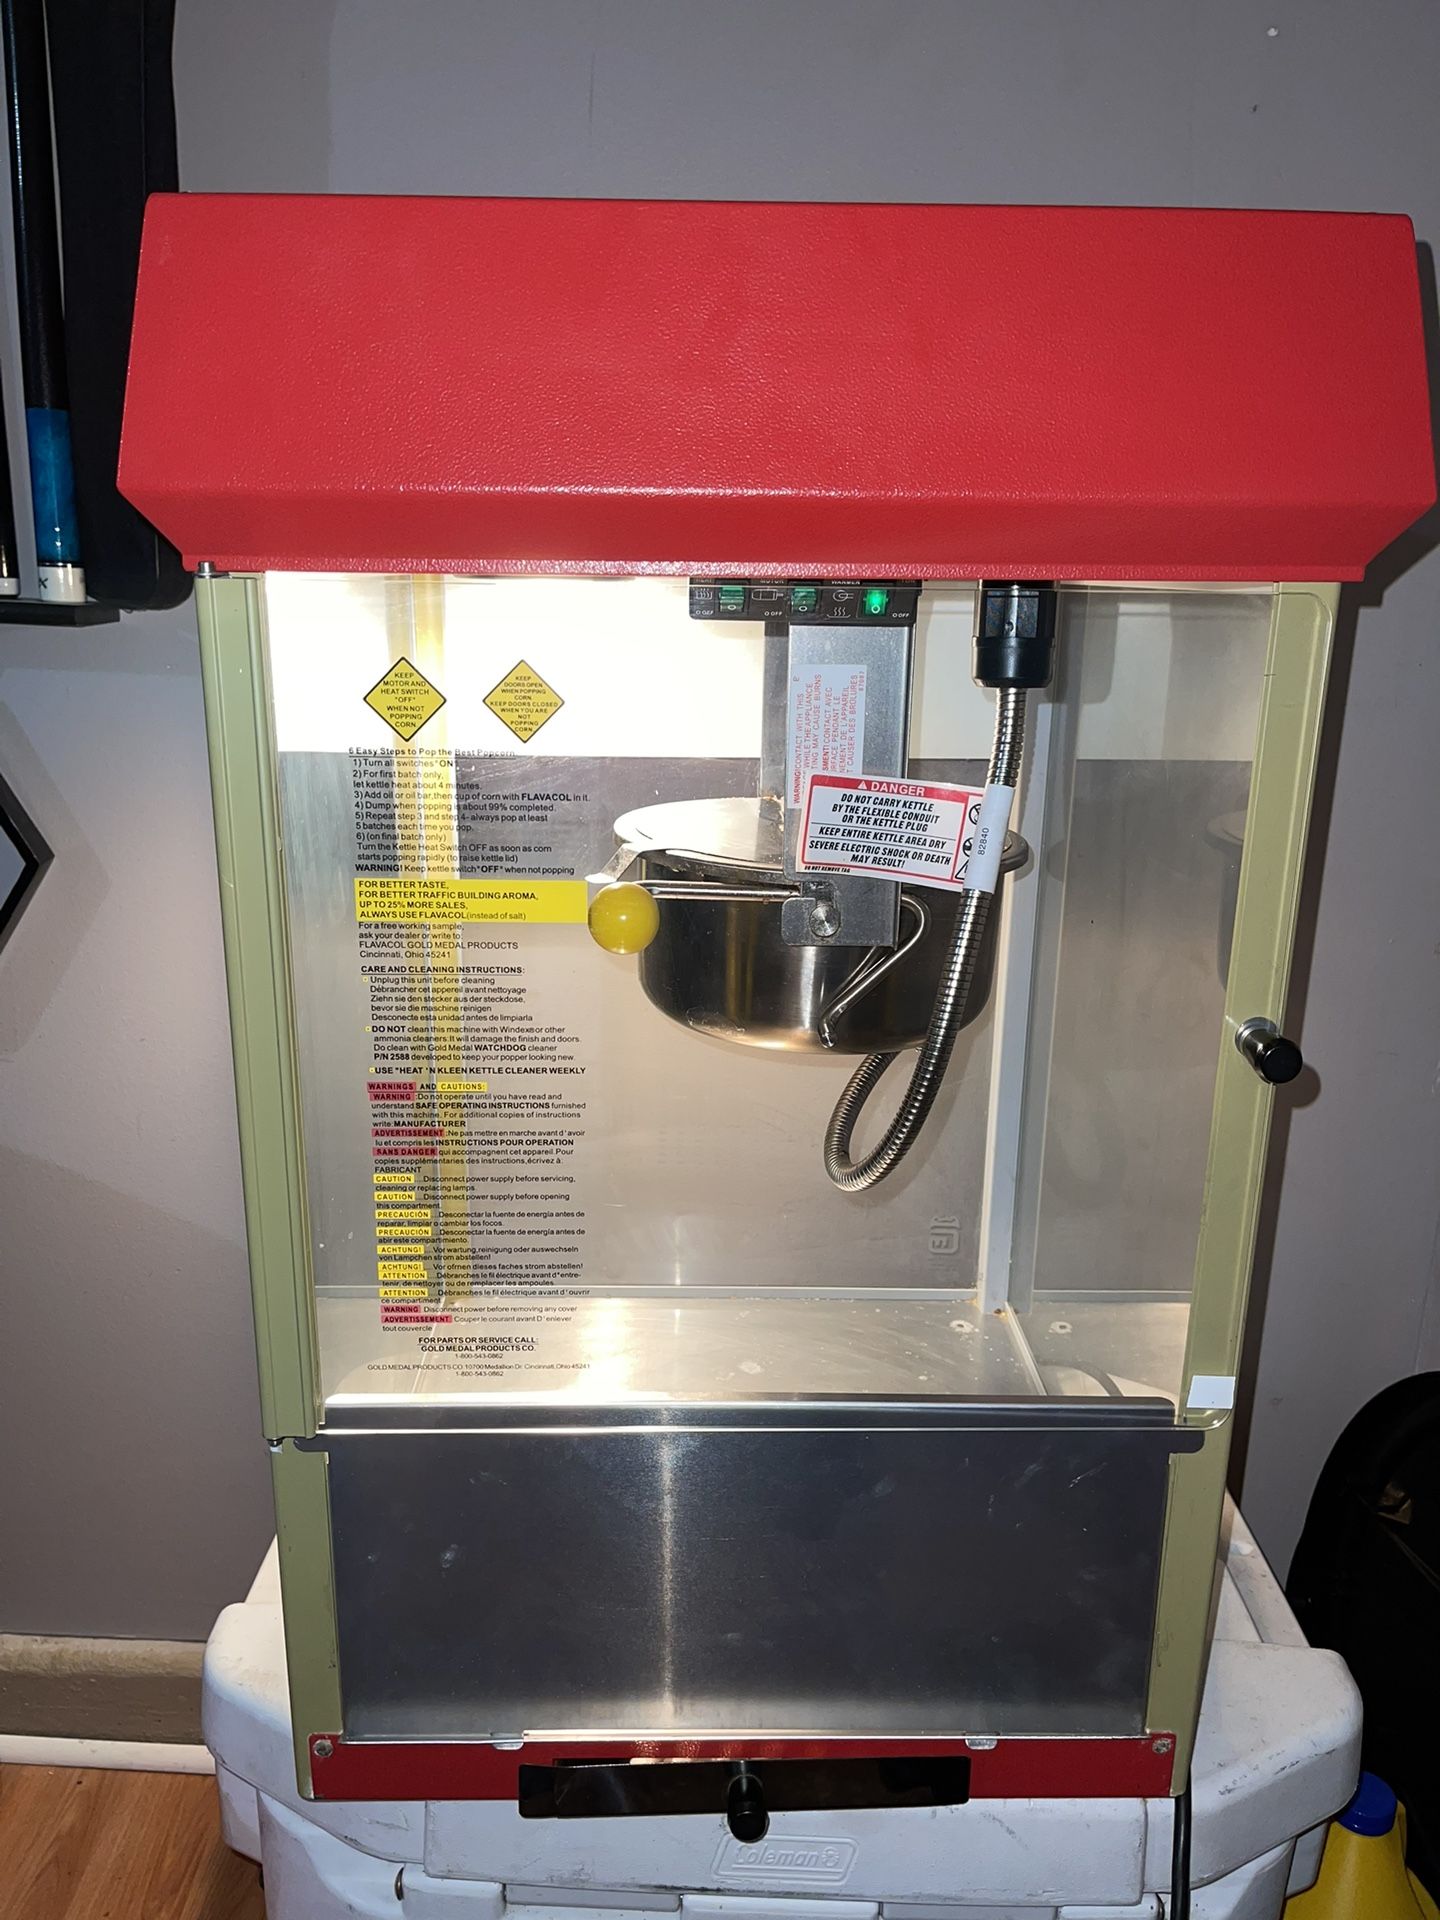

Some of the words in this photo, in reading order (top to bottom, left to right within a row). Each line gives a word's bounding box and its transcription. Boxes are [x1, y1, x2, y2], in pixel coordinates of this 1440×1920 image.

[383, 680, 409, 688] MOTOR
[410, 680, 426, 688] AND
[401, 688, 429, 696] SWITCH
[390, 713, 422, 721] POPPING
[395, 721, 416, 729] CORN
[871, 782, 925, 796] DANGER
[521, 793, 572, 802] FLAVACOL
[841, 794, 853, 802] DO
[854, 795, 871, 804] NOT
[873, 797, 901, 807] CARRY
[902, 800, 934, 811] KETTLE
[832, 804, 843, 812] BY
[844, 805, 861, 814] THE
[861, 807, 901, 819] FLEXIBLE
[902, 811, 940, 824] CONDUIT
[842, 814, 853, 823] OR
[854, 815, 871, 825] THE
[872, 817, 904, 829] KETTLE
[905, 822, 928, 832] PLUG
[819, 827, 840, 836] KEEP
[841, 829, 871, 840] ENTIRE
[872, 832, 904, 843] KETTLE
[905, 836, 928, 846] AREA
[929, 839, 946, 849] DRY
[978, 827, 990, 855] 82840
[809, 840, 840, 851] SEVERE
[841, 843, 880, 855] ELECTRIC
[882, 848, 909, 859] SHOCK
[912, 852, 923, 861] OR
[924, 854, 951, 865] DEATH
[851, 855, 869, 864] MAY
[872, 858, 905, 868] RESULT!
[359, 880, 378, 889] FOR
[380, 880, 416, 889] BETTER
[359, 890, 378, 899] FOR
[380, 890, 417, 899] BETTER
[418, 891, 456, 900] TRAFFIC
[458, 891, 500, 900] BUILDING
[360, 900, 373, 909] UP
[374, 900, 386, 909] TO
[387, 901, 405, 909] 25%
[407, 901, 434, 910] MORE
[360, 910, 397, 919] ALWAYS
[399, 910, 417, 919] USE
[359, 941, 406, 950] FLAVACOL
[408, 941, 433, 950] GOLD
[435, 941, 466, 950] MEDAL
[468, 941, 518, 950] PRODUCTS
[405, 950, 424, 959] Ohio
[426, 950, 450, 959] 45241
[361, 965, 386, 974] CARE
[388, 965, 407, 974] AND
[409, 965, 455, 974] CLEANING
[370, 977, 399, 985] Unplug
[401, 976, 414, 985] this
[417, 976, 431, 985] unit
[433, 976, 460, 985] before
[461, 977, 494, 985] cleaning
[374, 1053, 389, 1062] P/N
[391, 1053, 409, 1062] 2588
[462, 1054, 480, 1063] keep
[482, 1055, 499, 1064] your
[500, 1055, 528, 1064] popper
[375, 1066, 393, 1075] USE
[438, 1066, 467, 1075] KLEEN
[469, 1066, 503, 1075] KETTLE
[505, 1067, 548, 1075] CLEANER
[549, 1067, 586, 1076] WEEKLY
[369, 1083, 414, 1091] WARNINGS
[420, 1083, 436, 1091] AND
[374, 1092, 411, 1101] WARNING
[372, 1102, 414, 1110] understand
[416, 1101, 437, 1110] SAFE
[439, 1101, 487, 1110] OPERATING
[488, 1102, 550, 1110] INSTRUCTIONS
[551, 1102, 586, 1110] furnished
[375, 1129, 443, 1138] ADVERTISSEMENT
[436, 1138, 498, 1147] INSTRUCTIONS
[500, 1138, 524, 1147] POUR
[525, 1138, 574, 1147] OPERATION
[375, 1165, 421, 1174] FABRICANT
[376, 1175, 411, 1183] CAUTION
[377, 1193, 413, 1201] CAUTION
[384, 1305, 419, 1314] WARNING
[384, 1315, 449, 1324] ADVERTISSEMENT
[419, 1336, 436, 1345] FOR
[437, 1336, 463, 1345] PARTS
[465, 1336, 477, 1344] OR
[478, 1336, 513, 1344] SERVICE
[421, 1345, 444, 1353] GOLD
[446, 1344, 474, 1353] MEDAL
[476, 1344, 521, 1353] PRODUCTS
